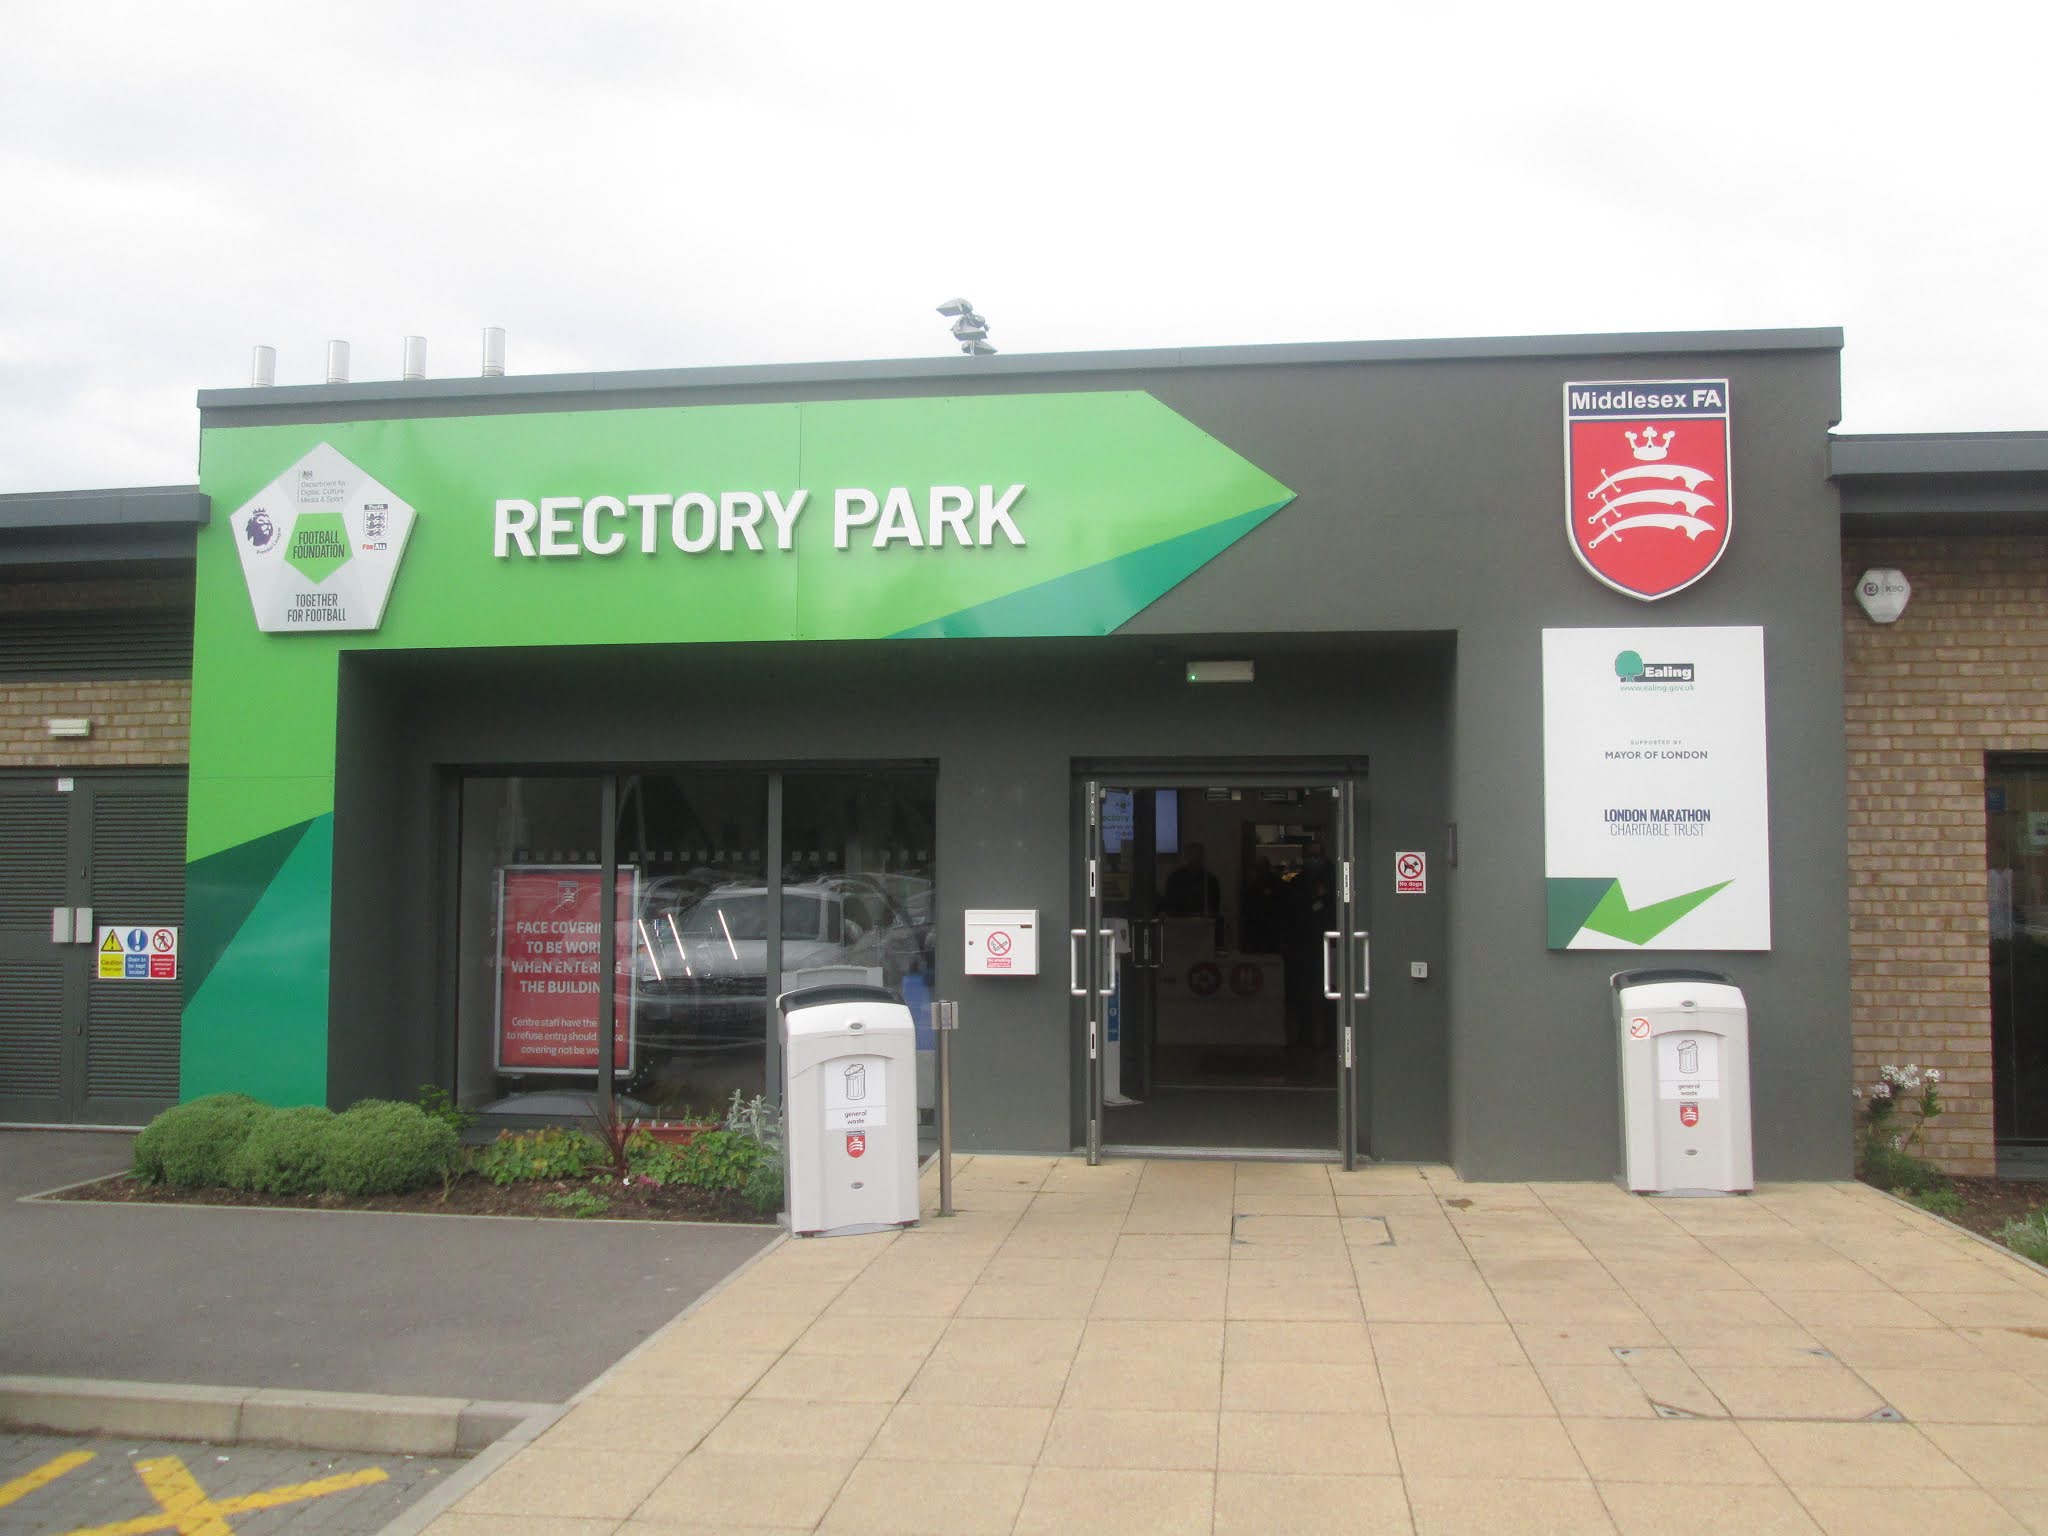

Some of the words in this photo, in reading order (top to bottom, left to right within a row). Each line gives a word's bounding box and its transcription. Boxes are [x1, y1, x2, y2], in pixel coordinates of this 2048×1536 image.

[1572, 391, 1687, 410] Middlesex
[1692, 389, 1722, 408] FA
[494, 490, 808, 558] RECTORY
[834, 484, 1026, 548] PARK
[298, 530, 339, 545] FOOTBALL
[293, 544, 345, 559] FOUNDATION
[295, 593, 338, 607] TOGETHER
[287, 609, 303, 622] FOR
[305, 608, 347, 622] FOOTBALL
[1645, 666, 1692, 680] Ealing
[1620, 684, 1695, 692] www.ealing.gov.uk
[1604, 751, 1641, 759] MAYOR
[1644, 751, 1658, 759] OF
[1661, 750, 1708, 759] LONDON
[1604, 808, 1647, 822] LONDON
[1650, 808, 1711, 822] MARATHON
[1610, 823, 1670, 836] CHARITABLE
[1673, 823, 1705, 836] TRUST
[516, 921, 548, 934] FACE
[551, 921, 601, 934] COVERI
[526, 941, 543, 954] TO
[546, 941, 562, 954] BE
[565, 941, 601, 954] WOR
[511, 961, 552, 974] WHEN
[520, 980, 545, 993] THE
[547, 980, 600, 994] BUILDIN
[512, 1017, 539, 1027] Centre
[541, 1017, 560, 1027] staff
[561, 1018, 581, 1027] have
[583, 1019, 598, 1028] the
[507, 1031, 516, 1040] to
[517, 1031, 543, 1040] refuse
[544, 1032, 567, 1042] entry
[569, 1032, 597, 1041] should
[521, 1045, 557, 1056] covering
[558, 1046, 573, 1055] not
[573, 1046, 585, 1055] be
[586, 1047, 600, 1055] wo
[845, 1110, 867, 1118] general
